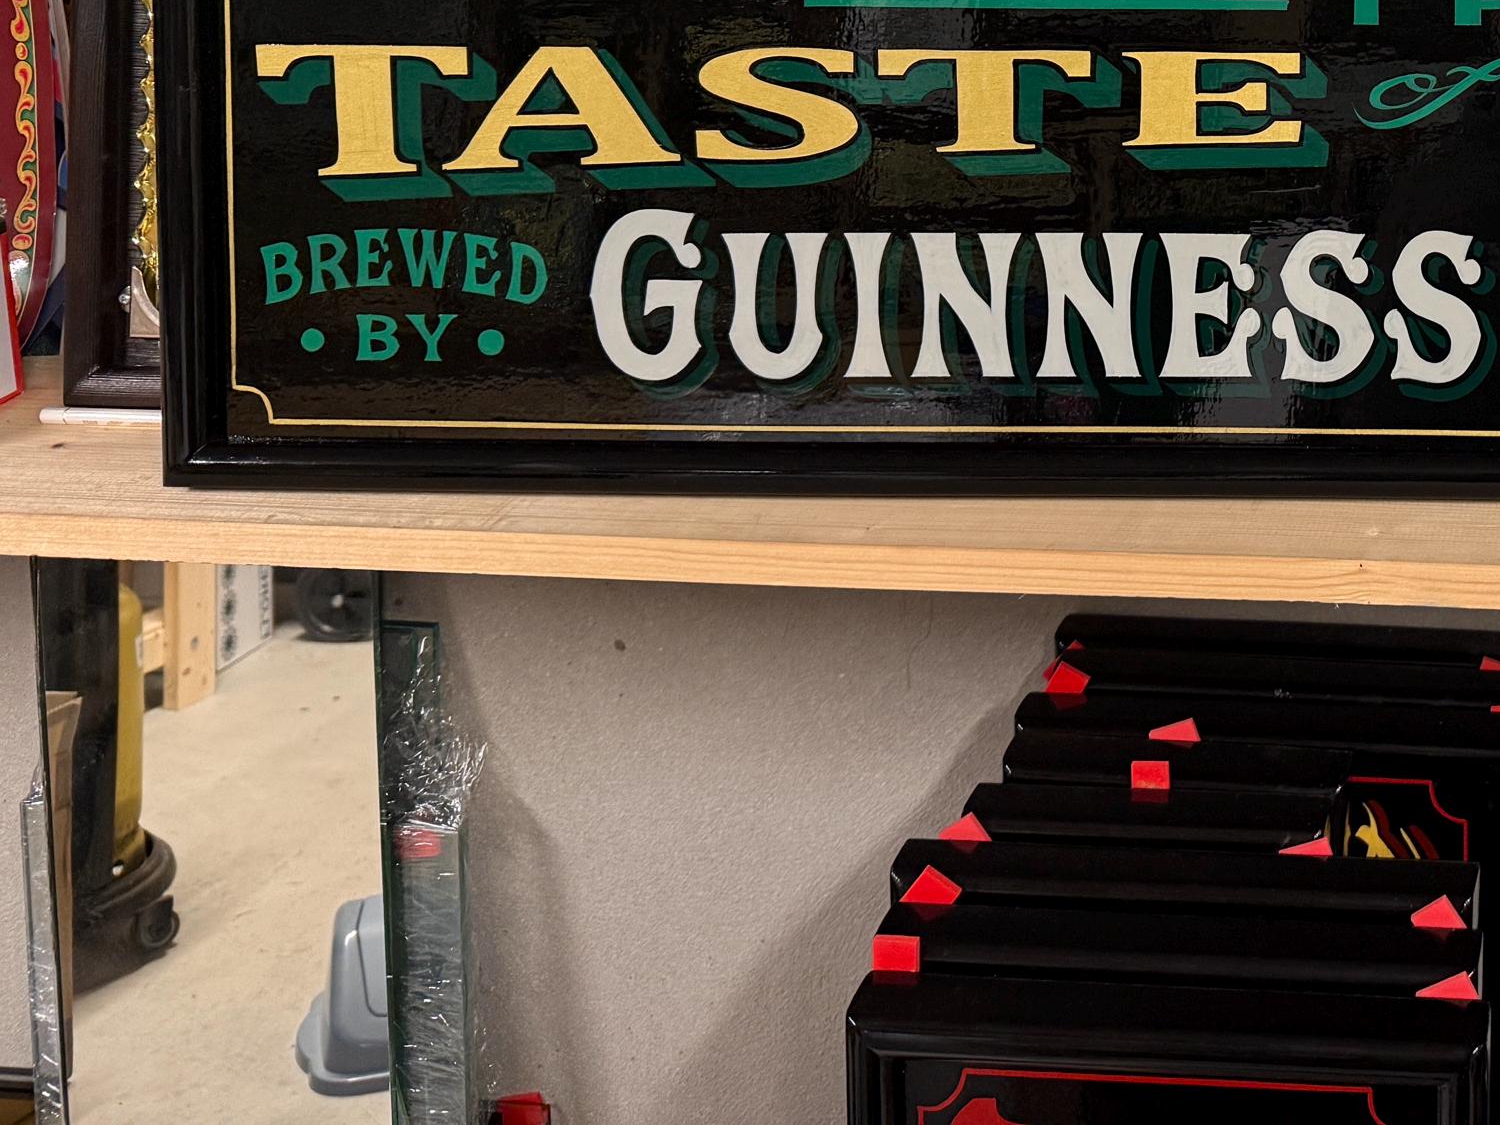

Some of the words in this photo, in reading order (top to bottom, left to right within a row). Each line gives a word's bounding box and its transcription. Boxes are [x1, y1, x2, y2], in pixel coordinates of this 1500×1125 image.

[256, 44, 1302, 177] TASTE
[260, 228, 548, 305] BREWED
[355, 314, 459, 362] BY
